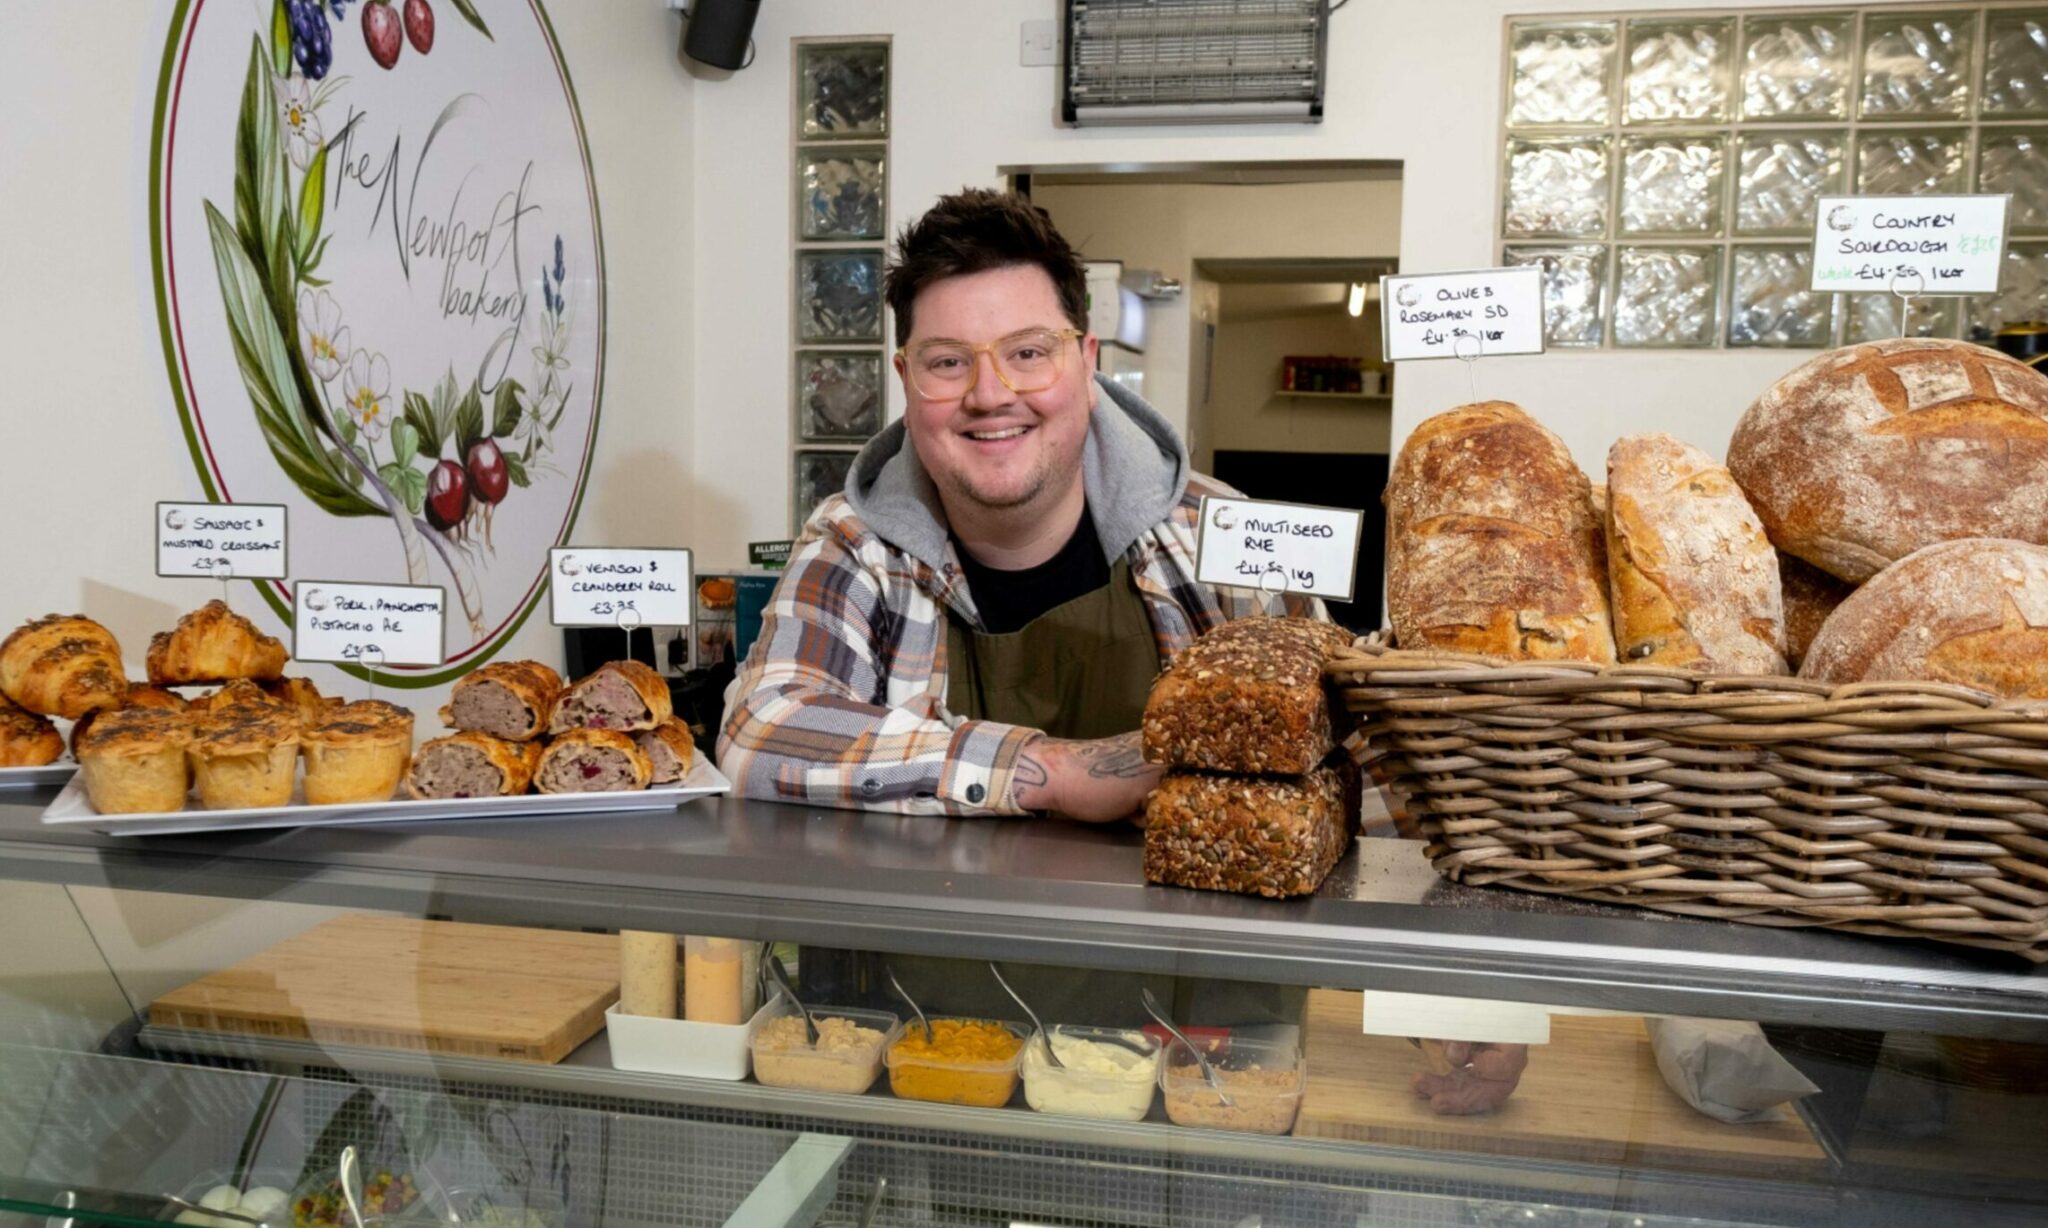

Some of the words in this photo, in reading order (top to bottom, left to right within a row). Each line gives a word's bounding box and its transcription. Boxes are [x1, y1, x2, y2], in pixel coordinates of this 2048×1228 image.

[326, 104, 376, 210] The
[368, 92, 541, 308] Newport
[1872, 213, 1956, 230] COUNTRY
[1838, 238, 1948, 254] SOURDOUGH
[1436, 287, 1480, 302] OLIVE
[1400, 309, 1473, 323] ROSEMARY
[1485, 305, 1509, 319] SD
[443, 270, 528, 395] bakery
[193, 517, 252, 531] SAUSAGE
[1245, 519, 1334, 538] MULTISEED
[162, 539, 214, 550] MUSTARD
[754, 543, 790, 555] ALLERGY
[1244, 536, 1275, 552] RYE
[586, 563, 643, 574] VENISON
[571, 582, 643, 593] CRANBERRY
[648, 580, 677, 592] ROLL
[310, 617, 374, 632] PISTACHIO
